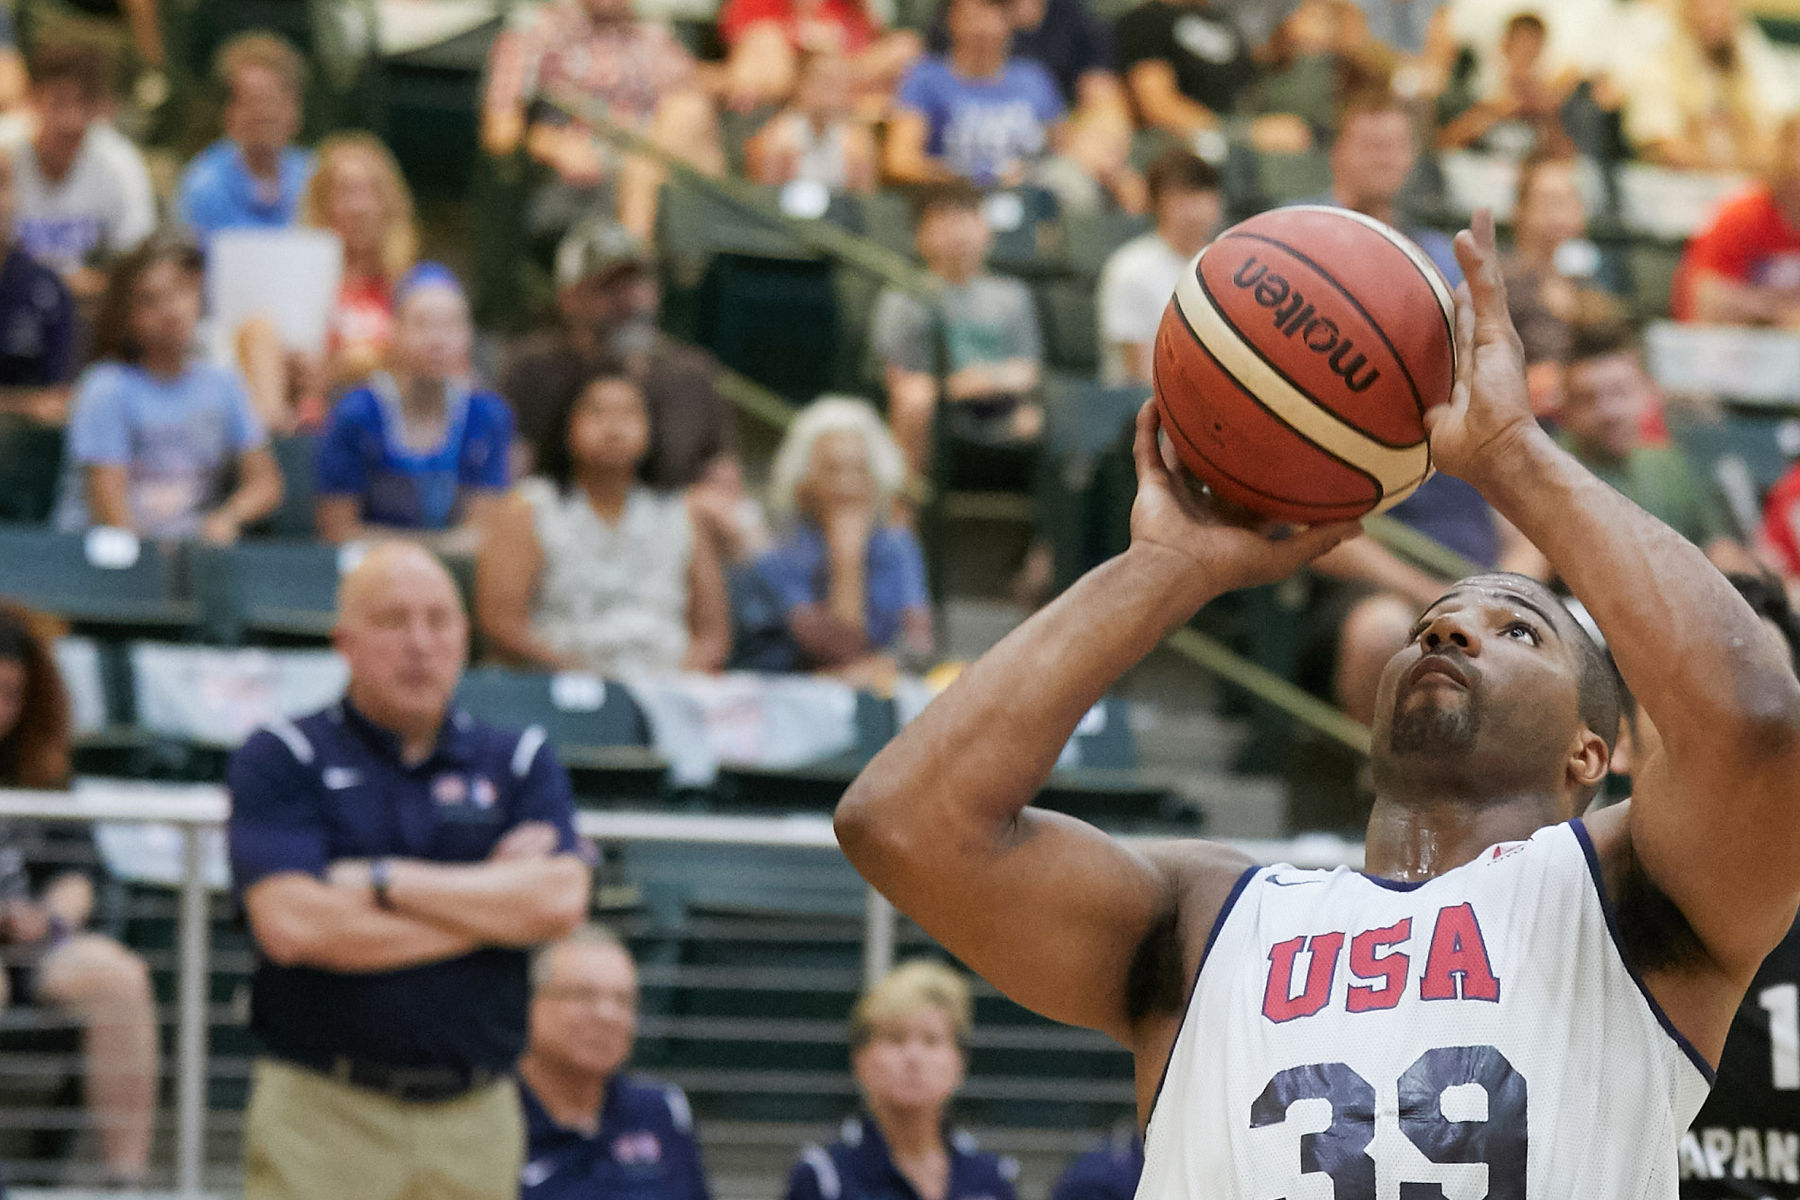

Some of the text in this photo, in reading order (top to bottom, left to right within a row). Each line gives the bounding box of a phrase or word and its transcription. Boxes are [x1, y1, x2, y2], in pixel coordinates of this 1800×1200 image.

[1233, 256, 1381, 393] molten
[1261, 901, 1501, 1024] USA
[1679, 1126, 1800, 1183] APAN
